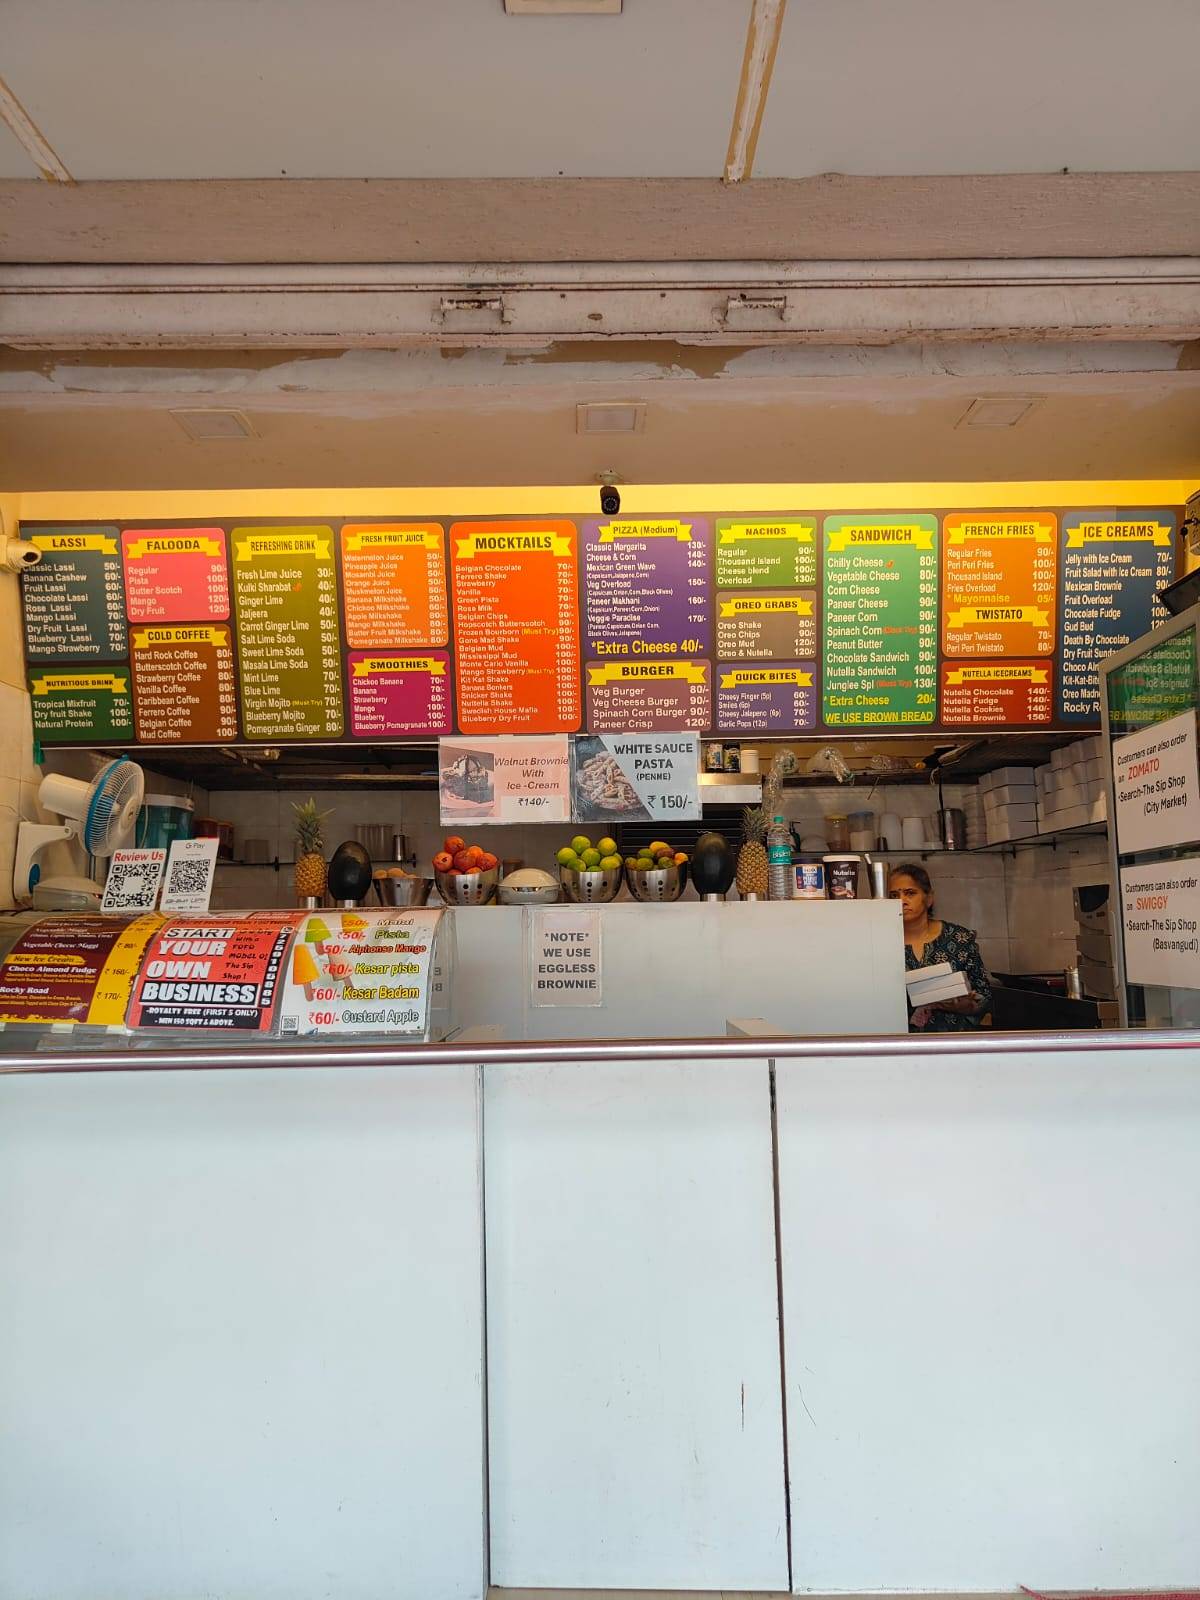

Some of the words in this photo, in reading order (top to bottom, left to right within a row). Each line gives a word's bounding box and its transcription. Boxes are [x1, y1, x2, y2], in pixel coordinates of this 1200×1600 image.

[613, 526, 637, 534] PIZZA
[640, 526, 678, 534] (Medium)
[965, 526, 1003, 535] FRENCH
[1007, 525, 1034, 535] FRIES
[1084, 527, 1102, 538] ICE
[1107, 526, 1153, 537] CREAMS
[851, 530, 911, 541] SANDWICH
[52, 539, 86, 547] LASSI
[147, 541, 200, 550] FALOODA
[251, 542, 292, 552] REFRESHING
[295, 541, 316, 550] DRINK
[475, 537, 552, 549] MOCKTAILS
[948, 549, 973, 558] Regular
[976, 549, 992, 557] Fries
[1037, 548, 1053, 556] 90/-
[1066, 554, 1080, 566] Jelly
[1083, 554, 1097, 563] with
[1099, 554, 1108, 563] Ice
[1111, 553, 1132, 563] Cream
[1157, 553, 1171, 562] 70/-
[105, 573, 121, 581] 60/-
[237, 570, 258, 579] Fresh
[260, 570, 277, 578] Lime
[280, 569, 302, 578] Juice
[318, 569, 333, 577] 30/-
[828, 572, 867, 581] Vegetable
[869, 572, 899, 580] Cheese
[920, 570, 936, 578] 80/-
[976, 610, 1023, 619] TWISTATO
[241, 623, 263, 631] Carrot
[265, 622, 291, 631] Ginger
[320, 621, 336, 629] 50/-
[148, 632, 172, 641] COLD
[176, 630, 210, 640] COFFEE
[632, 641, 677, 653] Cheese
[681, 640, 703, 652] 40/-
[154, 651, 172, 659] Rock
[174, 651, 198, 659] Coffee
[217, 650, 232, 658] 80/-
[371, 661, 428, 669] SMOOTHIES
[622, 666, 674, 676] BURGER
[994, 669, 1032, 677] ICECREAMS
[592, 688, 611, 697] Veg
[613, 687, 644, 697] Burger
[690, 686, 709, 694] 80/-
[34, 701, 64, 709] Tropical
[67, 699, 96, 707] Mixfruit
[114, 699, 130, 707] 70/-
[593, 709, 629, 718] Spinach
[632, 708, 658, 717] Corn
[661, 708, 687, 717] Burger
[826, 714, 841, 722] WE
[843, 713, 861, 722] USE
[864, 713, 898, 721] BROWN
[901, 712, 932, 720] BREAD
[594, 720, 624, 728] Paneer
[627, 720, 652, 729] Crisp
[685, 719, 710, 727] 120/-
[614, 745, 652, 755] WHITE
[655, 743, 693, 753] SAUCE
[1118, 749, 1145, 765] Customers
[1147, 746, 1156, 755] can
[1158, 740, 1169, 751] also
[1171, 733, 1187, 746] order
[494, 758, 528, 766] Walnut
[531, 757, 568, 766] Brownie
[635, 758, 673, 769] PASTA
[522, 769, 544, 778] With
[1128, 758, 1160, 780] ZOMATO
[636, 772, 671, 781] (PENNE)
[507, 781, 521, 790] Ice
[1156, 780, 1167, 793] Sip
[1168, 776, 1185, 788] Shop
[661, 794, 693, 809] 150/-
[1144, 801, 1159, 816] (City
[1160, 793, 1187, 809] Market)
[115, 853, 149, 861] Review
[151, 852, 164, 860] Us
[1126, 882, 1153, 893] Customers
[1155, 882, 1165, 890] can
[1166, 879, 1179, 889] also
[1180, 877, 1197, 888] order
[1136, 896, 1168, 910] SWIGGY
[1165, 920, 1176, 933] Sip
[1178, 919, 1196, 933] Shop
[166, 929, 234, 937] START
[375, 931, 409, 939] Pista
[159, 941, 228, 956] YOUR
[395, 944, 426, 953] Mango
[1153, 938, 1198, 952] (Basvangudi)
[544, 948, 562, 957] WE
[567, 948, 591, 957] USE
[147, 961, 211, 980] OWN
[355, 964, 388, 974] Kesar
[392, 963, 419, 974] pista
[539, 964, 596, 973] EGGLESS
[538, 979, 597, 989] BROWNIE
[141, 983, 256, 1003] BUSINESS
[343, 987, 376, 999] Kesar
[379, 986, 419, 998] Badam
[309, 1012, 339, 1024] ₹60/-
[342, 1011, 384, 1023] Custard
[387, 1010, 419, 1024] Apple
